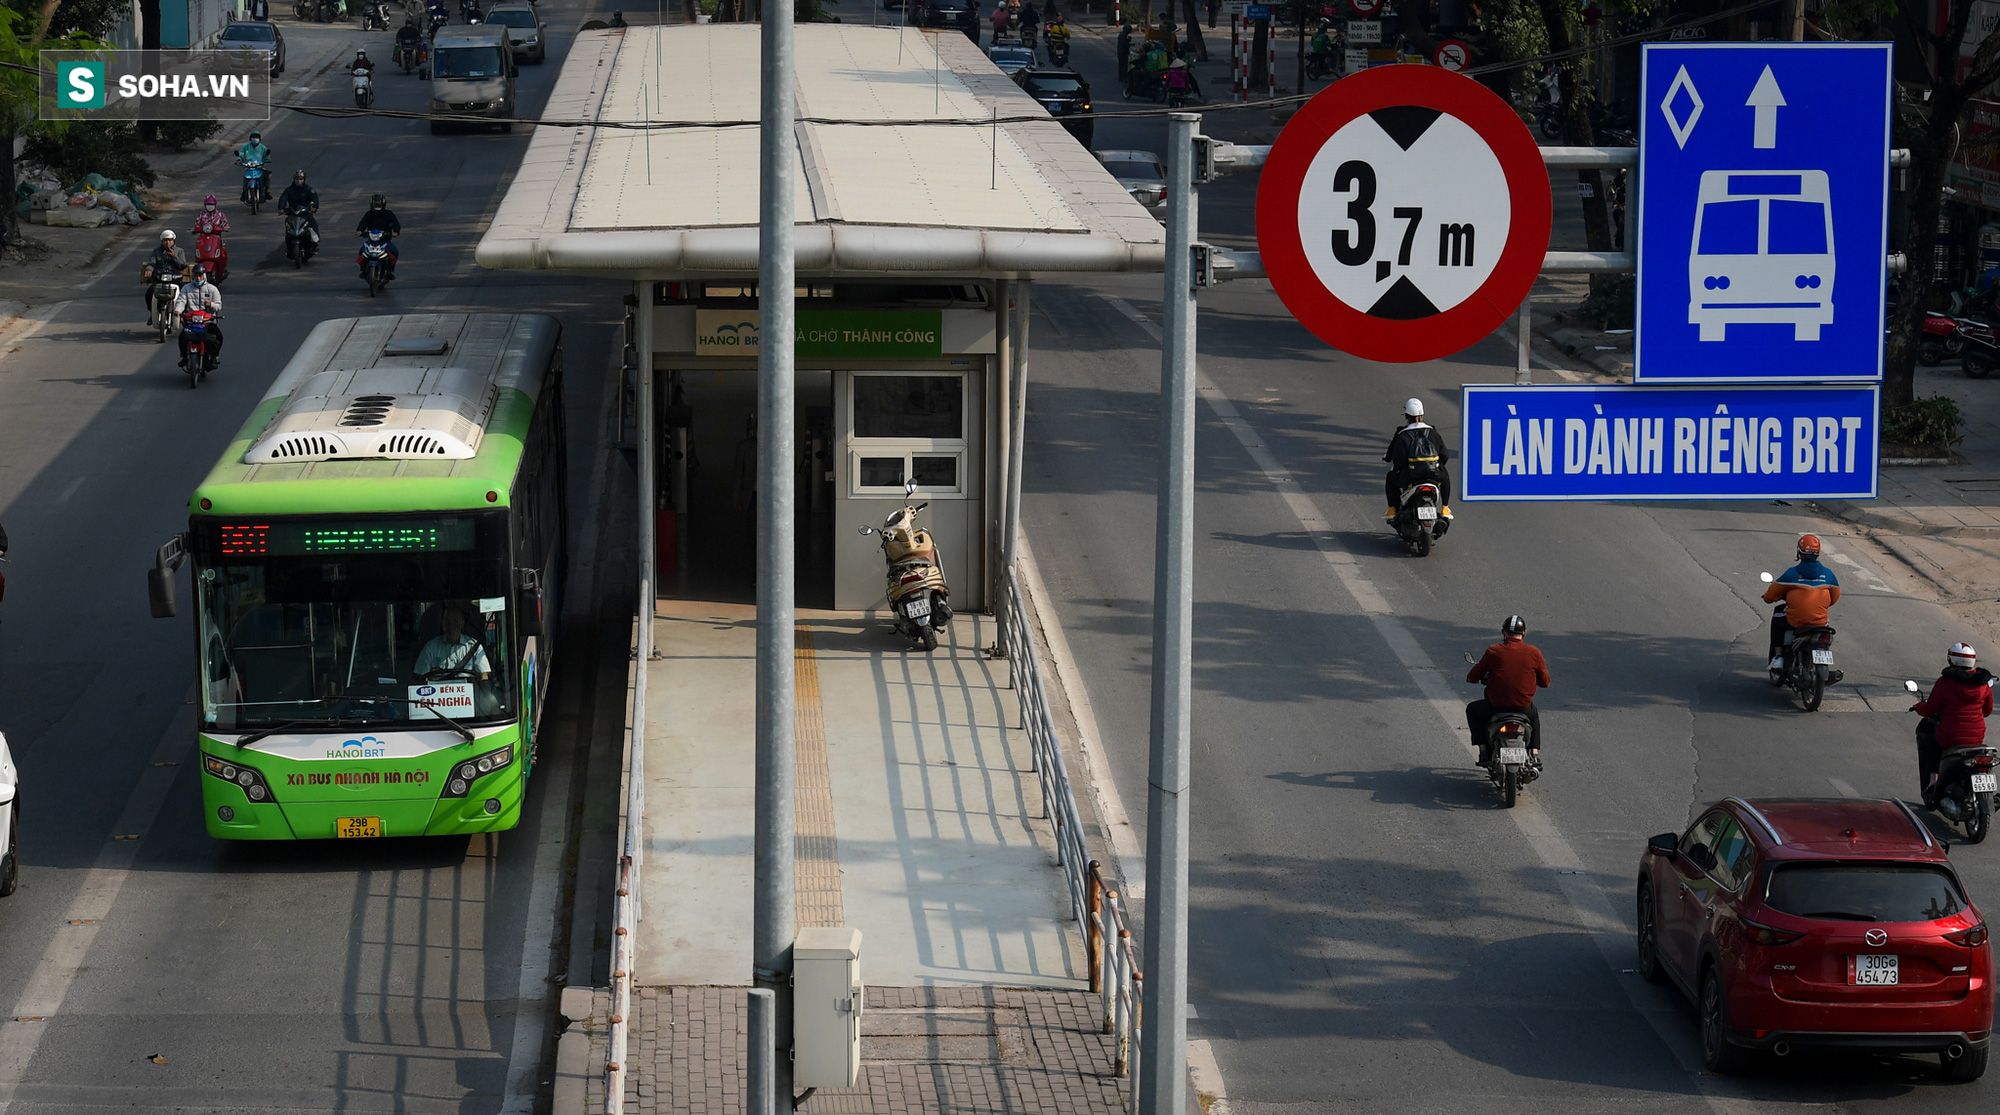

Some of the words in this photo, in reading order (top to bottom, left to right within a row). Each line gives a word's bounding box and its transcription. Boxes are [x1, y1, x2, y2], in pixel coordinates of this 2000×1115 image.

[1438, 223, 1475, 267] m
[699, 335, 739, 346] HANOI
[744, 335, 759, 346] BR
[809, 327, 838, 343] CHỜ
[842, 328, 892, 343] THÀNH
[895, 328, 935, 343] CÔNG
[1481, 404, 1553, 475] LÀN
[1564, 404, 1663, 475] DÀNH
[1673, 404, 1782, 475] RIÊNG
[1792, 417, 1861, 473] BRT
[420, 687, 433, 695] BRT
[437, 695, 472, 707] NGHĨA
[326, 749, 363, 759] HANOI
[364, 748, 386, 758] BRT
[308, 773, 331, 785] BUS
[334, 772, 380, 785] NHANH
[384, 769, 401, 784] HÀ
[404, 769, 430, 787] NỘI
[349, 818, 368, 827] 29B
[343, 827, 376, 837] 153.42
[1866, 955, 1889, 969] 30G
[1857, 970, 1898, 984] 454.73
